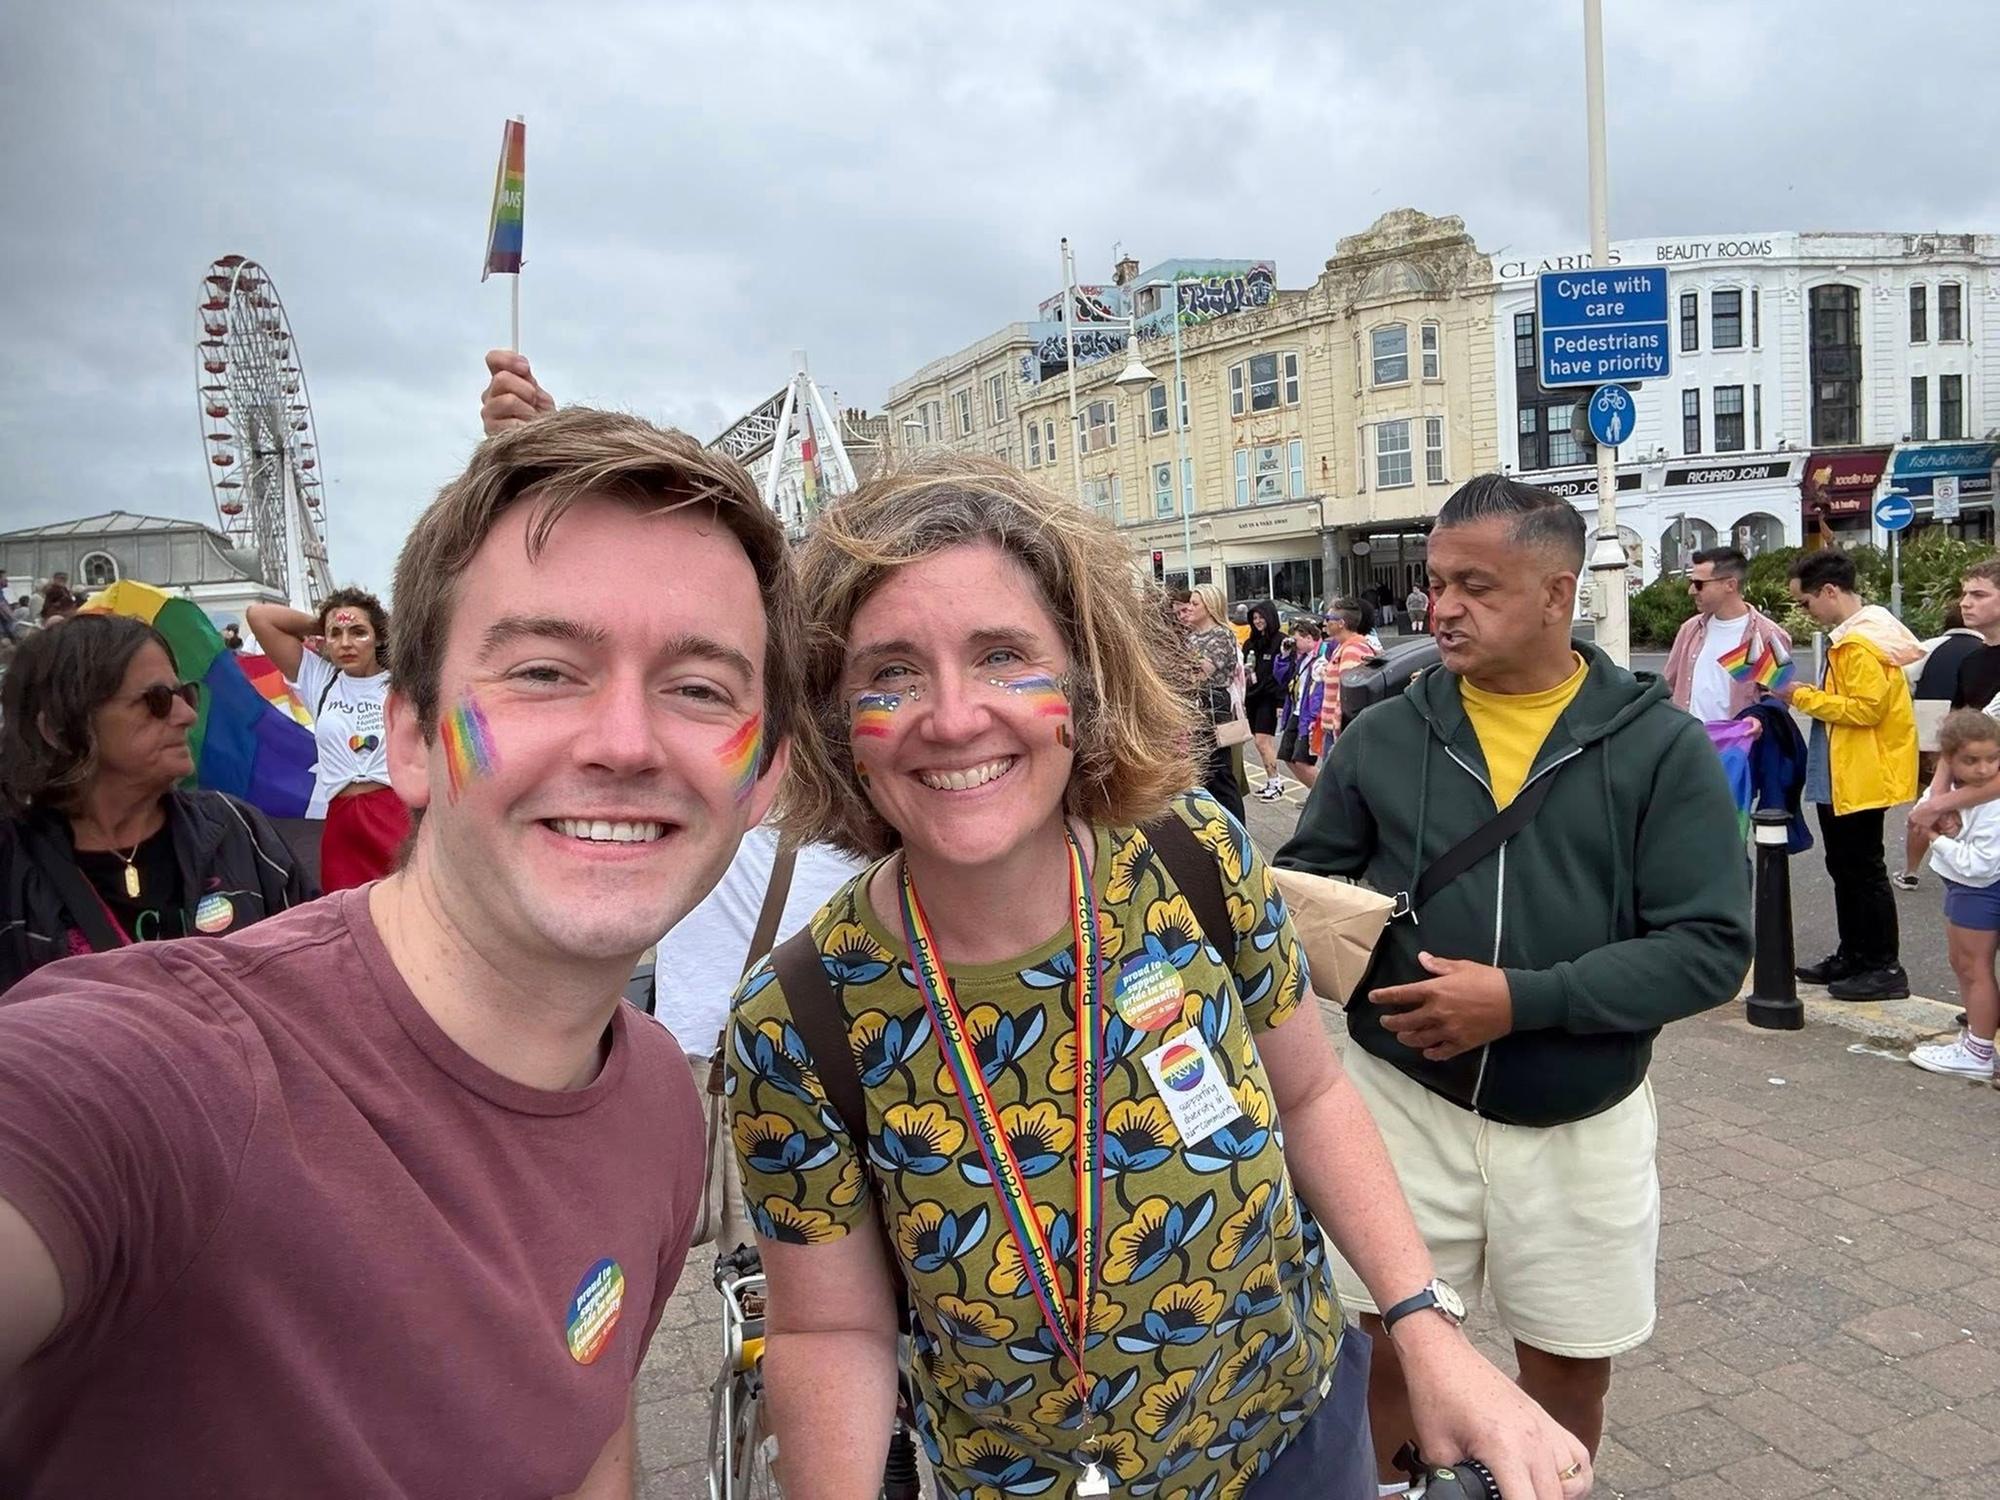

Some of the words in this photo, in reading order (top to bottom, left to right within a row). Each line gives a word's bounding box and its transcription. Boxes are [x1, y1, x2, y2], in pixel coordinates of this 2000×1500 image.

[1657, 243, 1712, 261] BEAUTY
[1717, 240, 1773, 257] ROOMS
[1558, 279, 1608, 299] Cycle
[1614, 275, 1651, 294] with
[1586, 302, 1625, 317] care
[1554, 332, 1659, 354] Pedestrians
[1550, 359, 1592, 376] have
[1598, 353, 1664, 375] priority
[1687, 470, 1736, 484] RICHARD
[1738, 466, 1770, 480] JOHN
[1861, 473, 1877, 484] bar
[1078, 896, 1097, 944] 2022
[1083, 954, 1097, 1006] Pride
[1122, 962, 1150, 988] proud
[1151, 960, 1162, 971] to
[1127, 970, 1164, 994] support
[912, 937, 938, 990] Pride
[931, 996, 962, 1045] 2022
[1122, 989, 1146, 1011] pride
[1147, 986, 1158, 996] in
[1158, 976, 1177, 990] our
[1125, 988, 1180, 1018] community
[1083, 1060, 1097, 1108] 2022
[1179, 1083, 1219, 1111] supporting
[1184, 1102, 1216, 1124] diversity
[967, 1092, 997, 1146] Pride
[991, 1152, 1021, 1202] 2022
[1083, 1119, 1097, 1172] Pride
[1084, 1228, 1097, 1277] 2022
[576, 1271, 602, 1312] proud
[602, 1265, 612, 1281] to
[1029, 1246, 1054, 1300] Pride
[580, 1276, 612, 1320] support
[573, 1310, 597, 1344] pride
